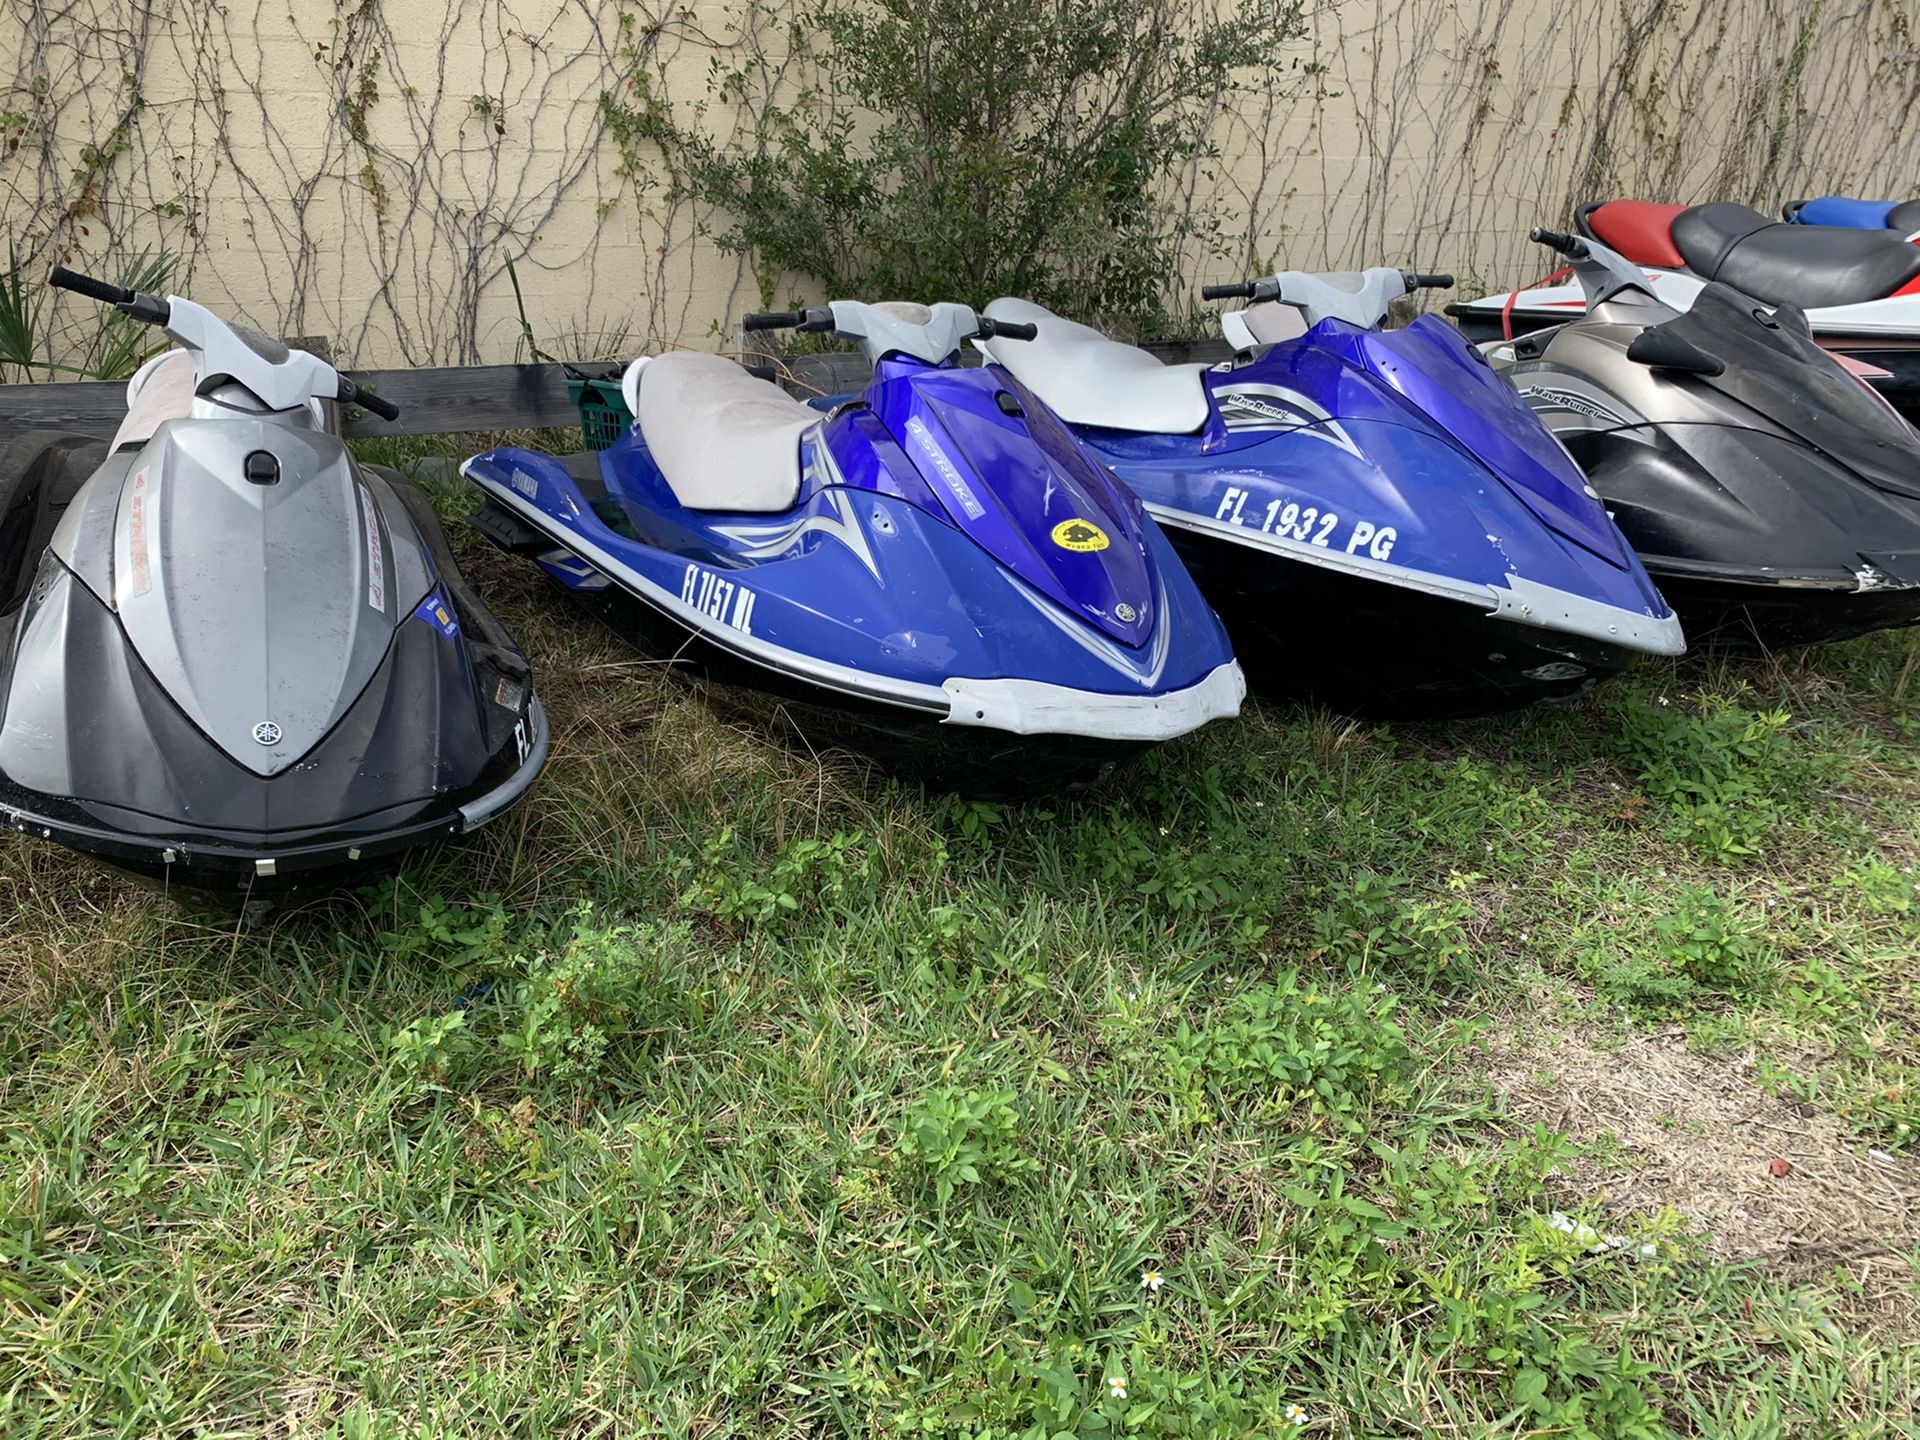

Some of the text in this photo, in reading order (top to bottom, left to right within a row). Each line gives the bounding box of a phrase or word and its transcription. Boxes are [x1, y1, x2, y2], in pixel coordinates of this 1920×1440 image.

[1229, 394, 1288, 419] WaveRunner
[1530, 385, 1600, 418] WaveRunner
[909, 422, 979, 515] 4 STROKE
[1215, 487, 1397, 561] FL 1932 PG
[682, 563, 699, 607] FL
[697, 571, 735, 623] 7157
